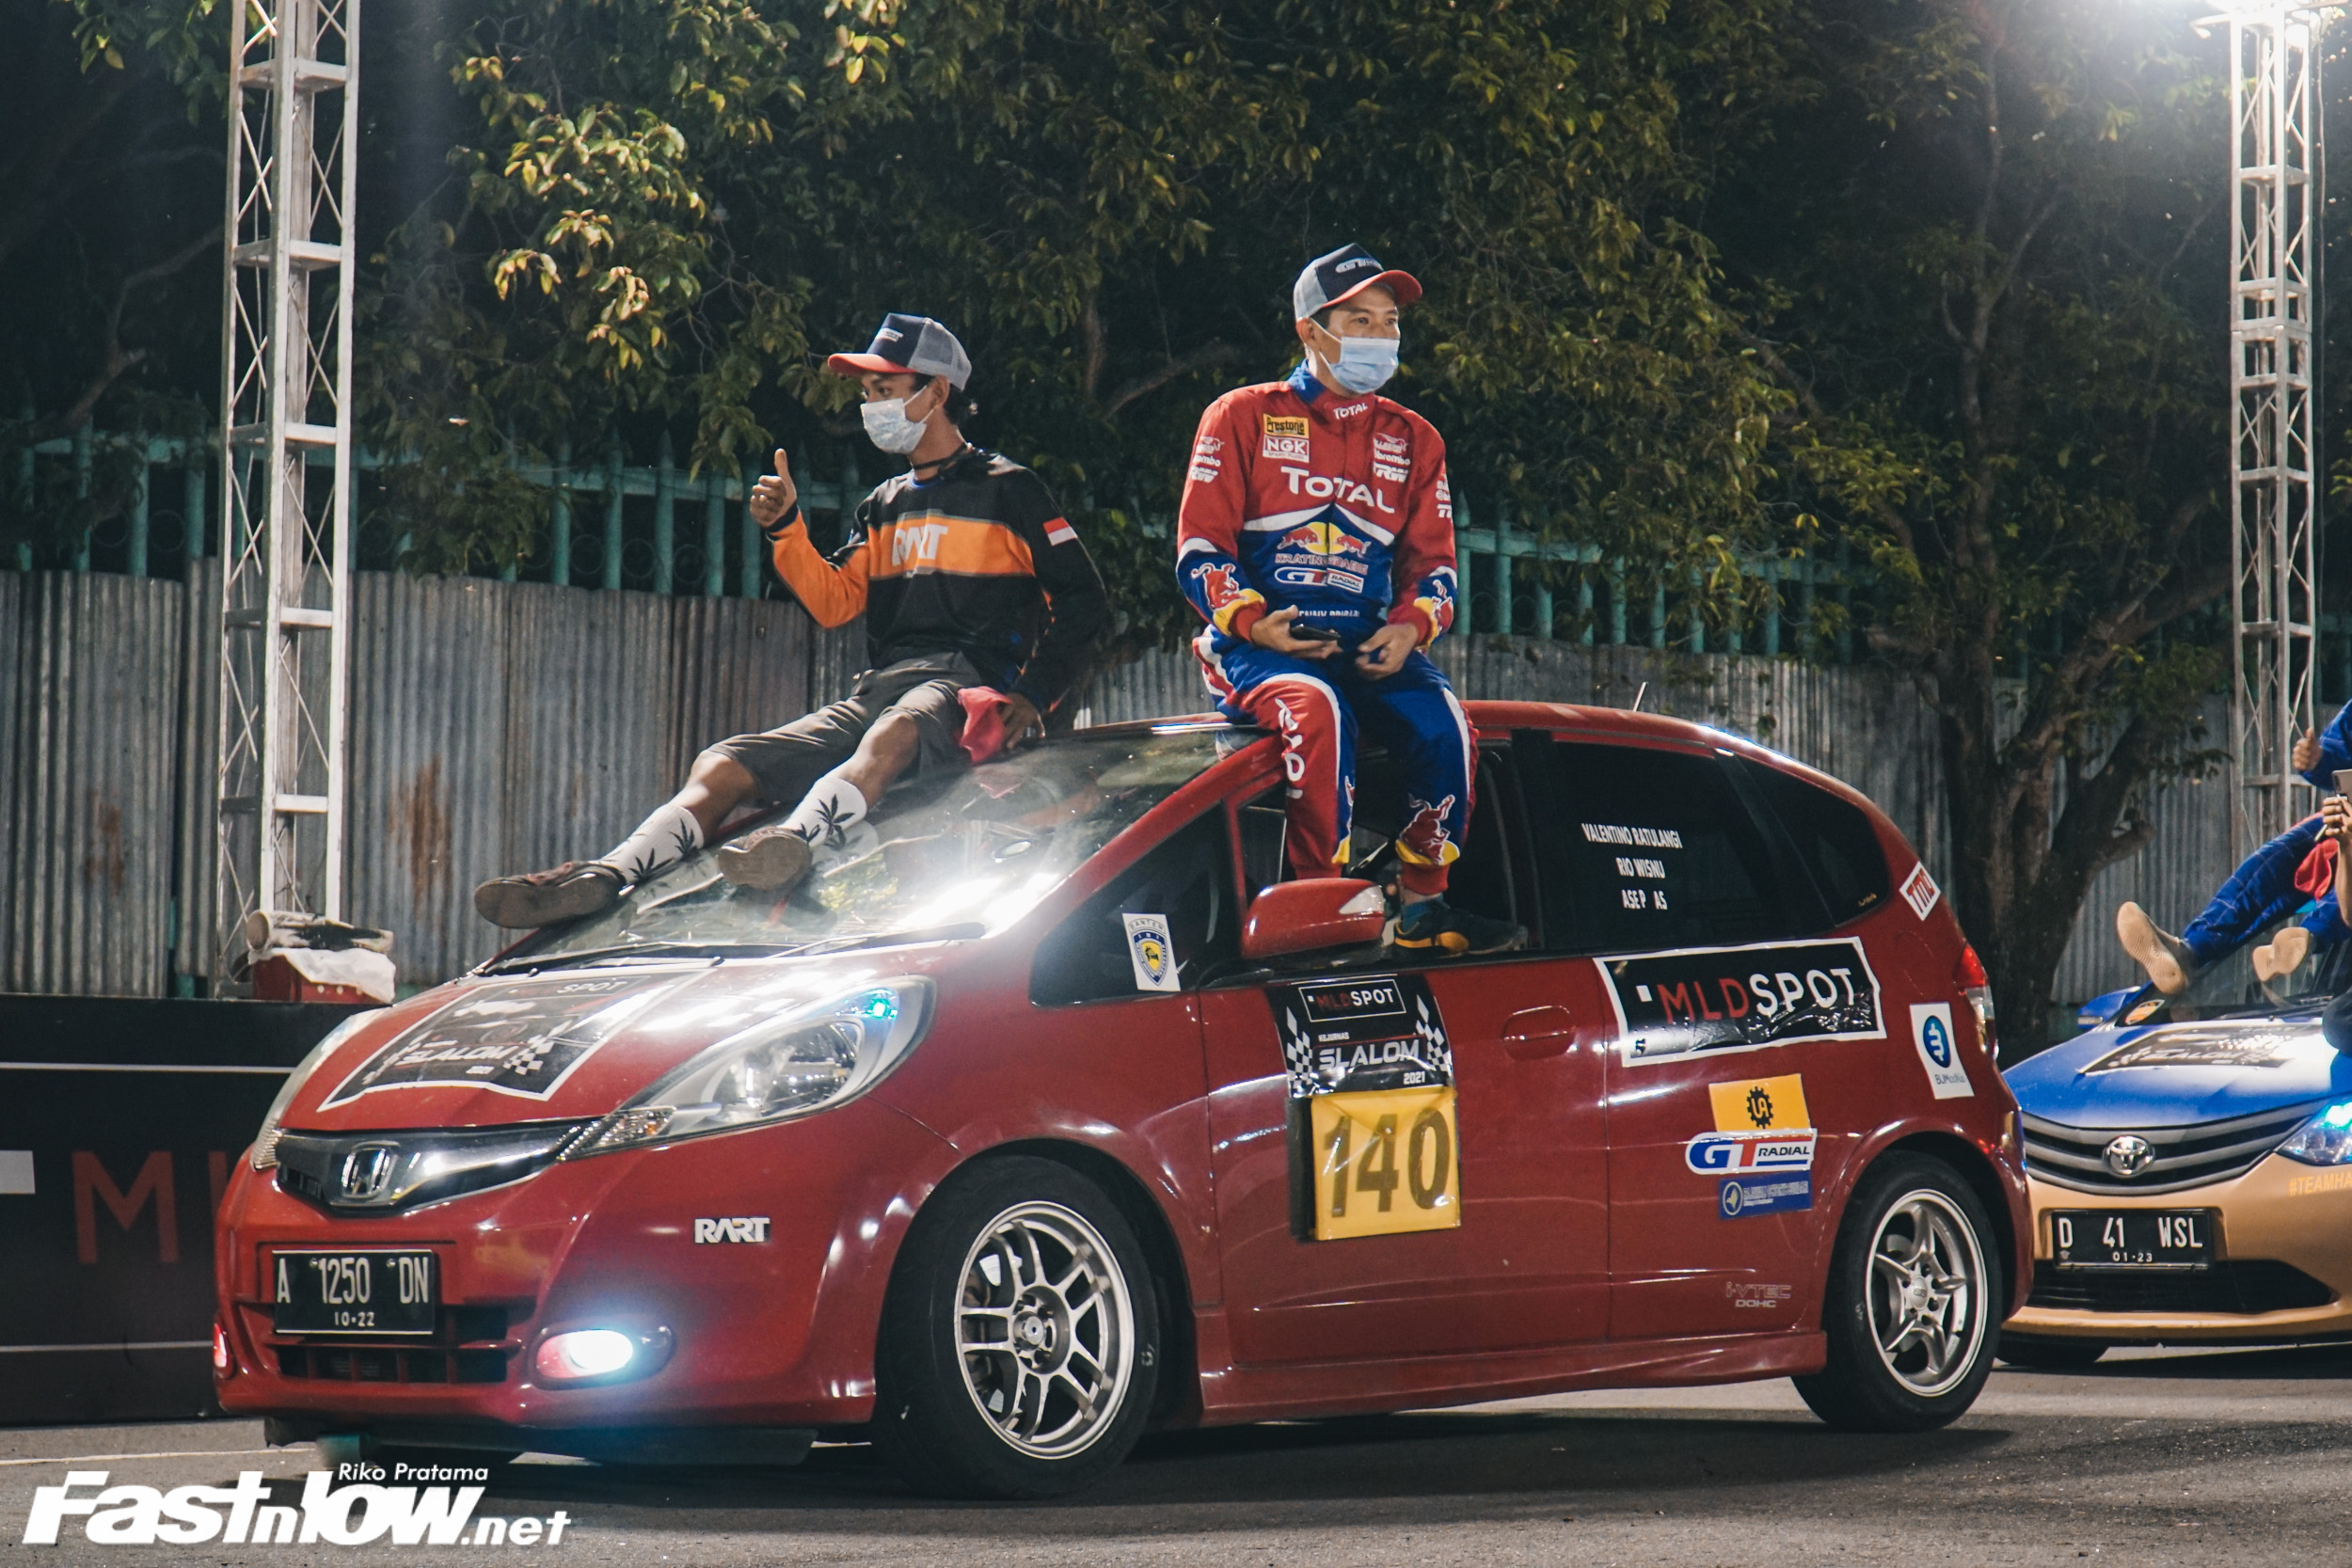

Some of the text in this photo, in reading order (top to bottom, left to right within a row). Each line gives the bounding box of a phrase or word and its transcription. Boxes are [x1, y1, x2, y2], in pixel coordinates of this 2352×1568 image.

[1333, 403, 1368, 420] TOTAL
[1266, 417, 1306, 436] Prestone
[1266, 436, 1306, 455] NGK
[1280, 467, 1395, 514] TOTAL
[1581, 823, 1683, 848] VALENTINO RATULANGI
[1615, 857, 1666, 879] RIO WISNU
[1653, 890, 1668, 911] AS
[1317, 988, 1394, 1009] MLDSPOT
[1657, 967, 1854, 1024] MLDSPOT
[1319, 1039, 1420, 1072] SLALOM
[1403, 1070, 1425, 1085] 2021
[1323, 1107, 1451, 1218] 140
[1690, 1136, 1810, 1169] GT RADIAL
[2058, 1216, 2203, 1248] D 41 WSL
[278, 1257, 429, 1304] A 1250 DN
[1735, 1299, 1776, 1308] DOHC
